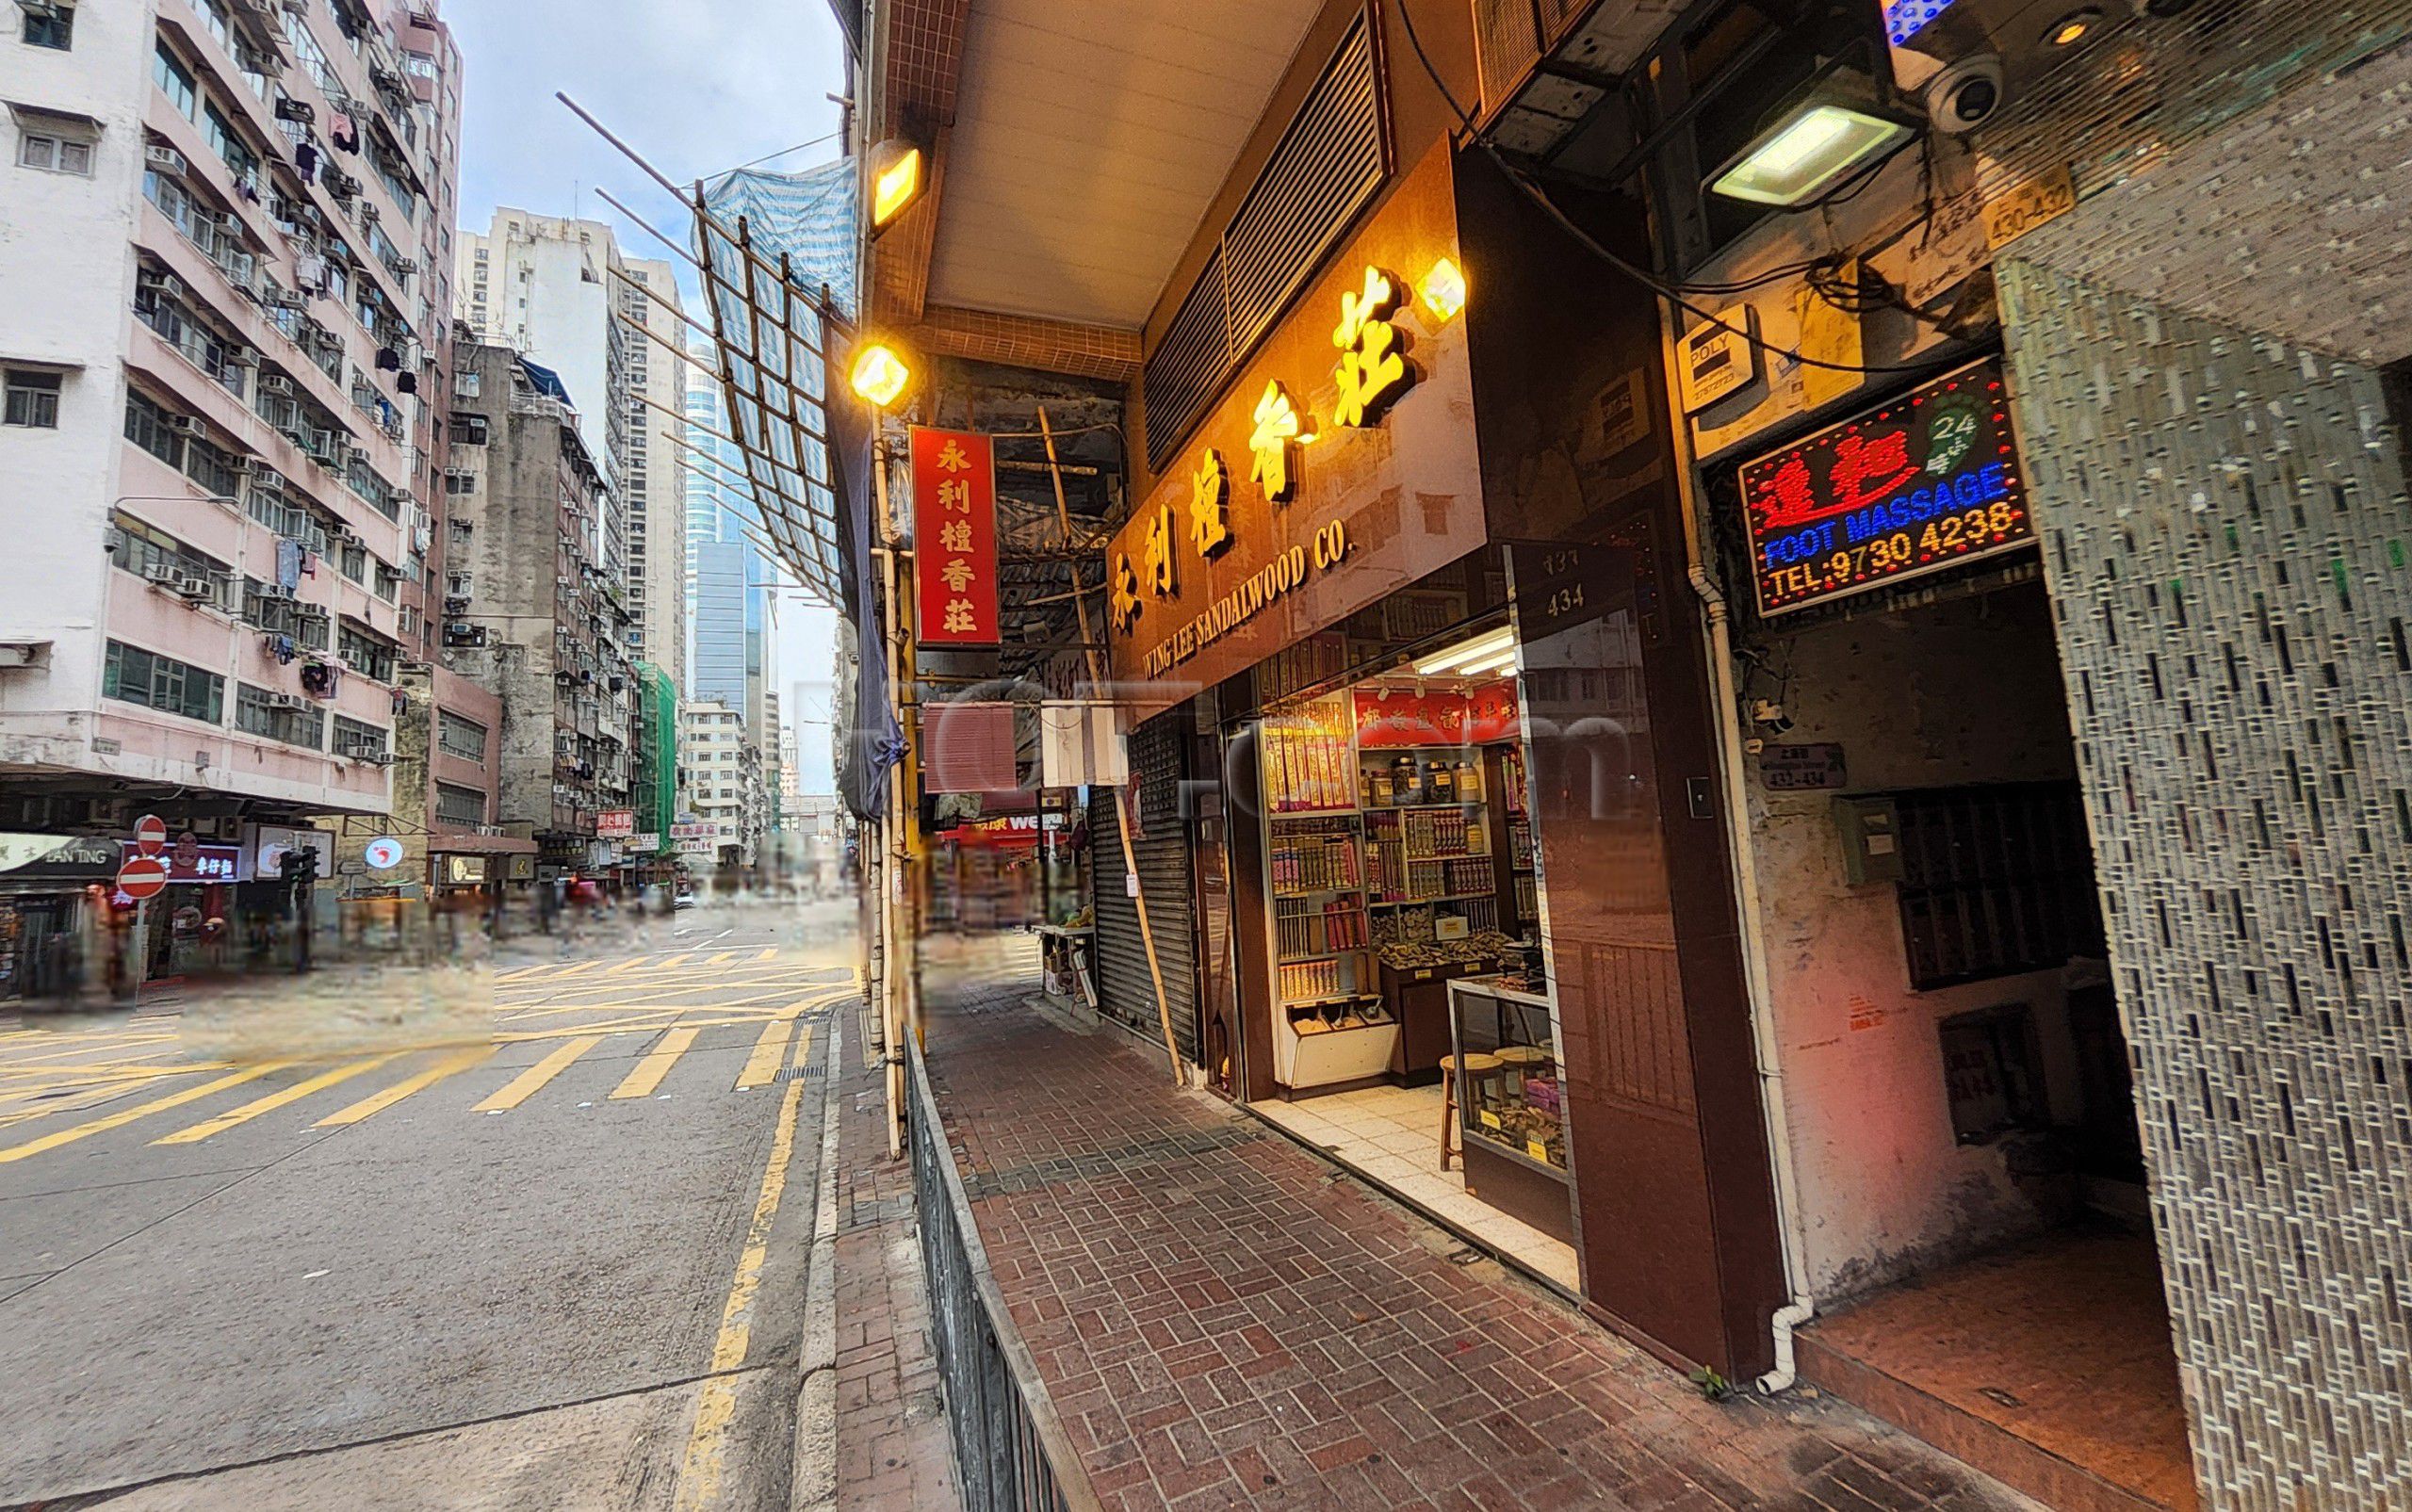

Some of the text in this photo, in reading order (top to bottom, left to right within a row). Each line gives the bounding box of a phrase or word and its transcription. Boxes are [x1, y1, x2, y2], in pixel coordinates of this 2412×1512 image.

[1690, 333, 1730, 367] POLY
[1113, 265, 1404, 628] 永利檀香莊
[1932, 415, 1977, 441] 24
[937, 438, 978, 634] 永利檀香莊
[1764, 461, 2010, 569] FOOT MASSAGE
[1919, 501, 2013, 551] 4238
[1143, 519, 1354, 680] WING LEE SANDALWOOD CO.
[1548, 583, 1585, 616] 434
